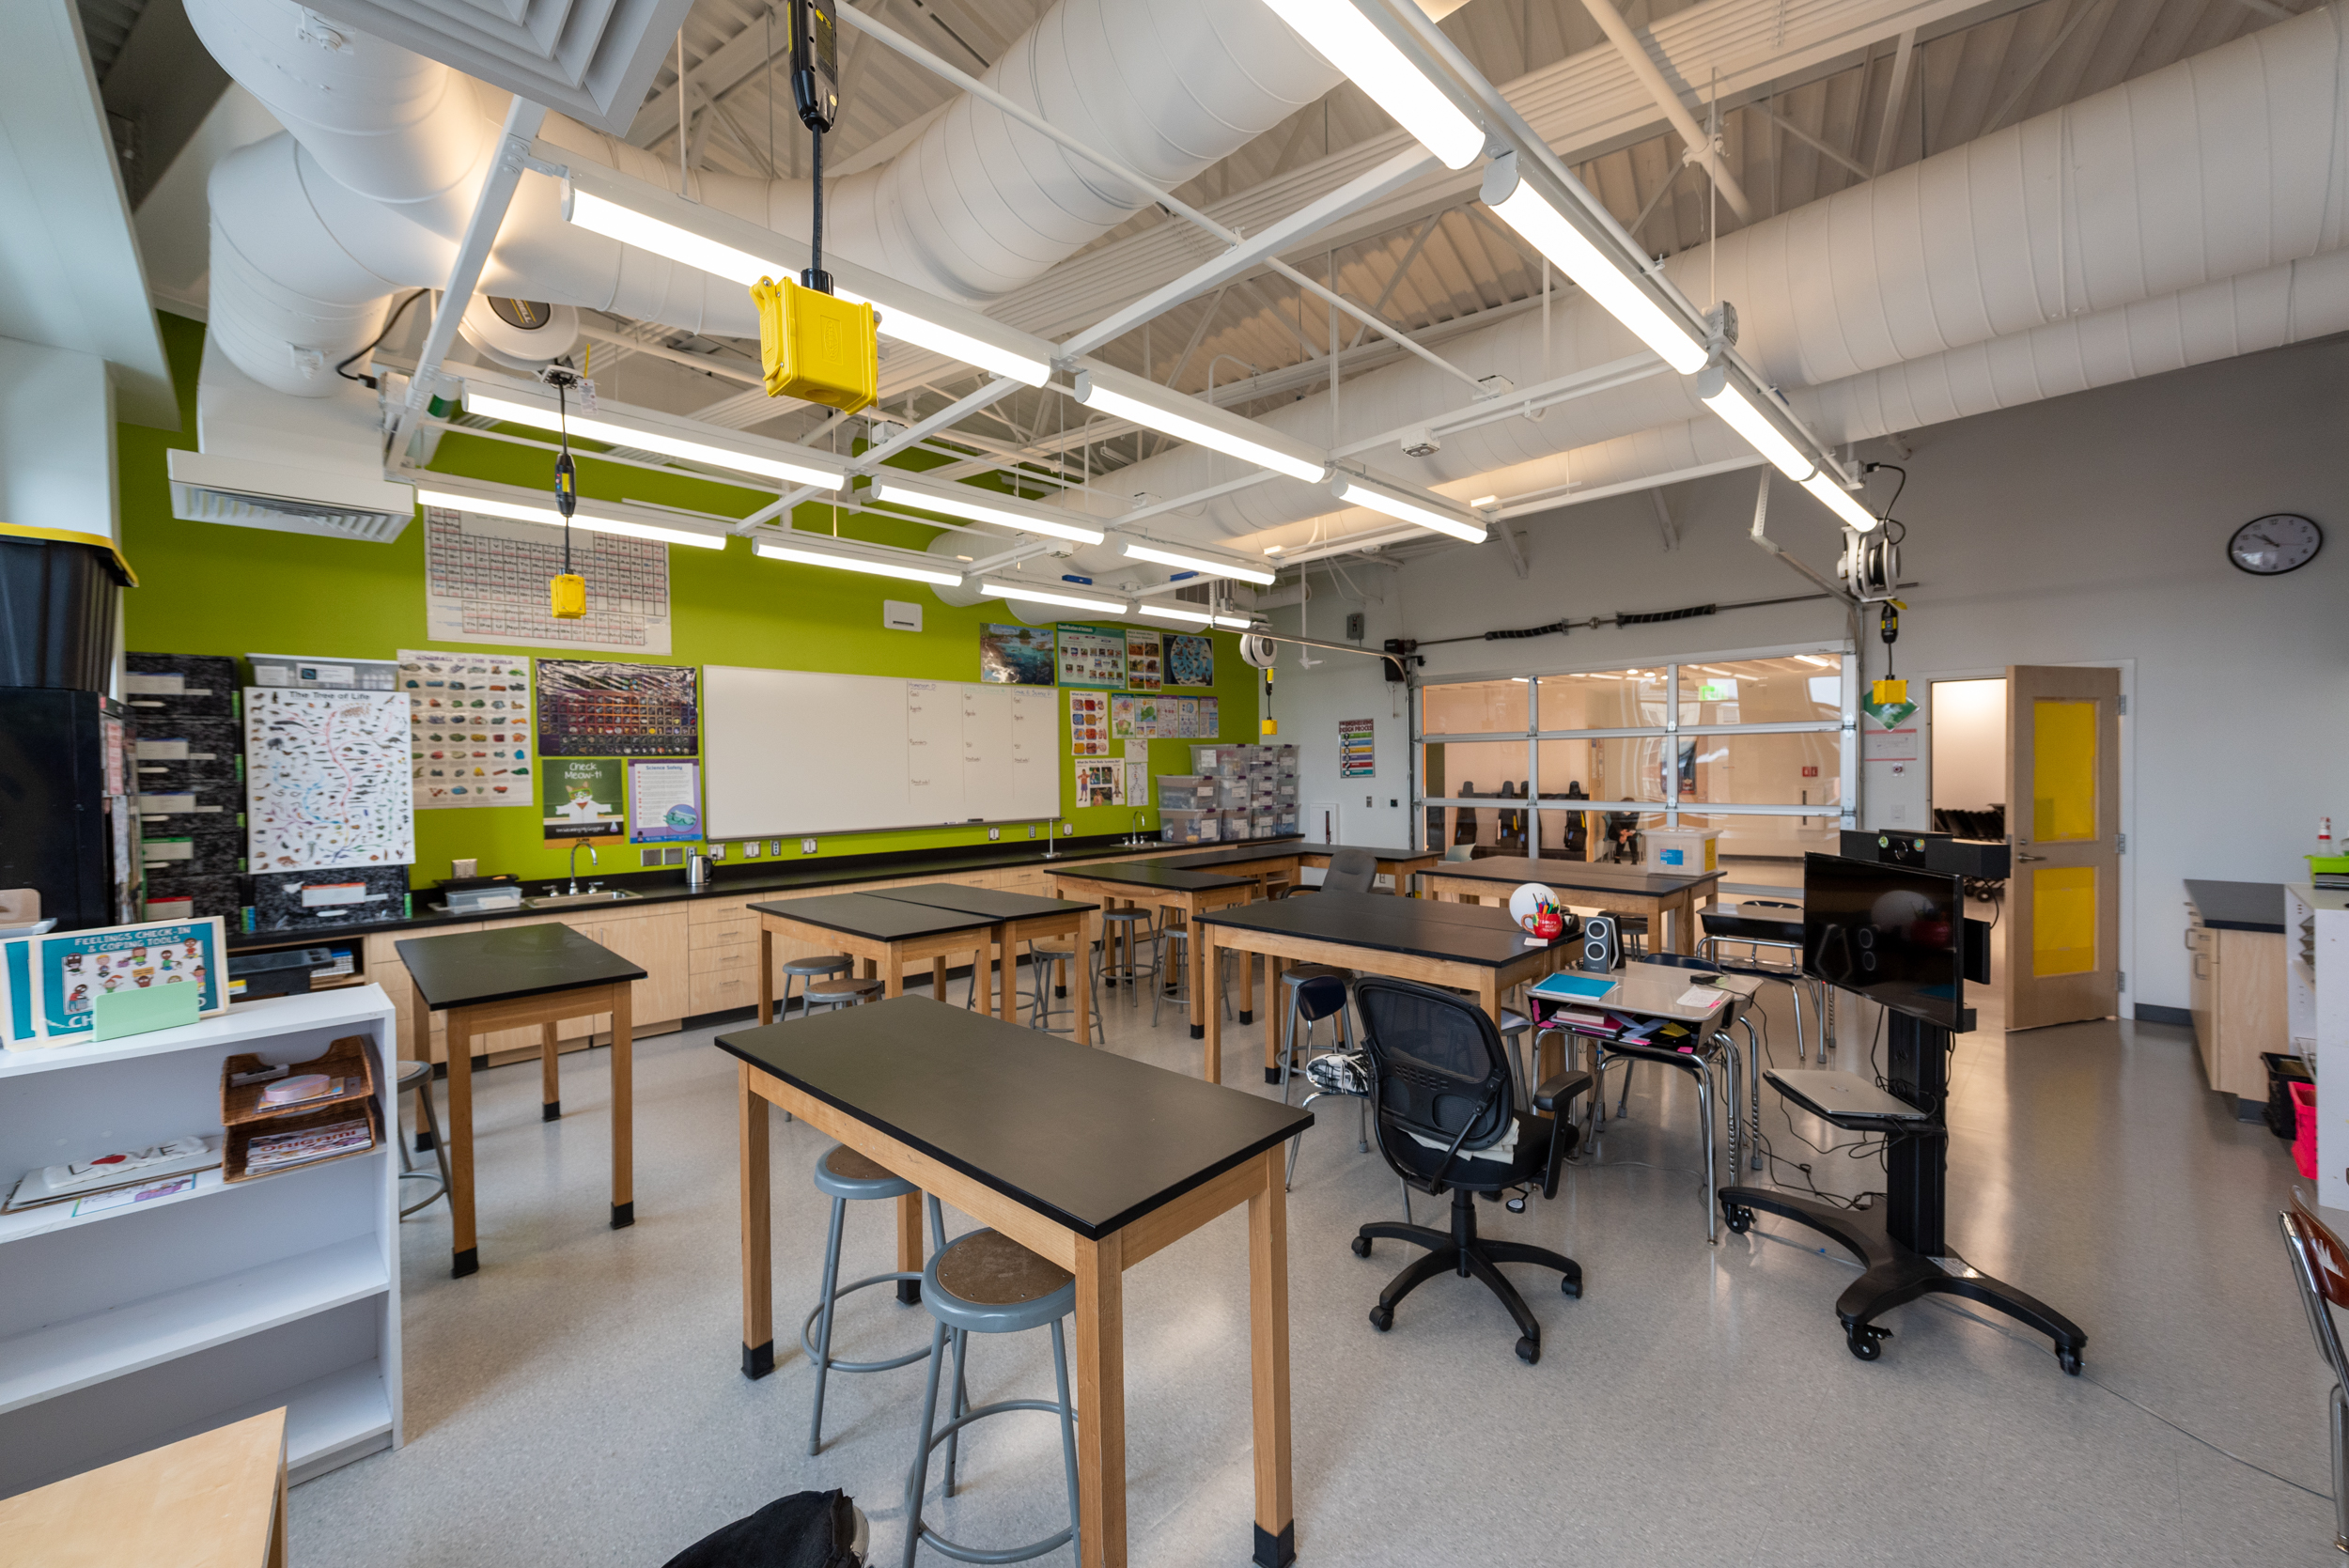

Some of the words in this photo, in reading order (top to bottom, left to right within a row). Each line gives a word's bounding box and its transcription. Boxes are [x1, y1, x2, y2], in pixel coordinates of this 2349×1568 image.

[564, 771, 602, 779] Meow-t!
[569, 762, 597, 771] Check
[75, 933, 132, 946] FEELINGS
[135, 926, 191, 939] CHECK-IN
[99, 940, 145, 951] COPING
[146, 935, 181, 946] TOOLS
[261, 1130, 356, 1151] ORIGAMI
[68, 1144, 179, 1175] LVE
